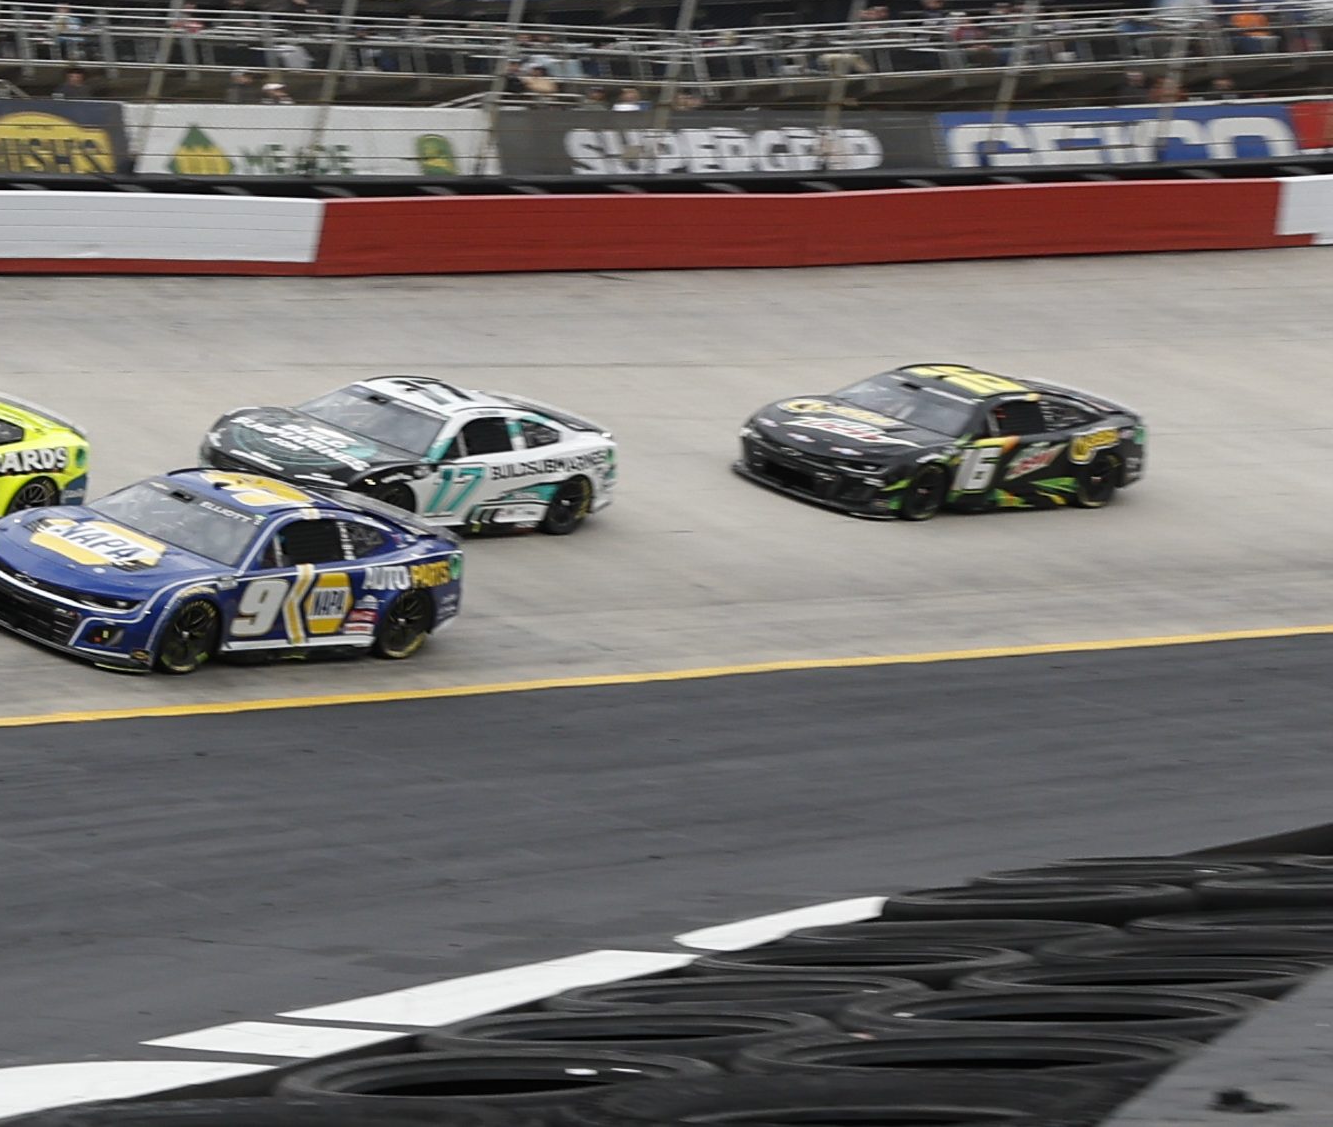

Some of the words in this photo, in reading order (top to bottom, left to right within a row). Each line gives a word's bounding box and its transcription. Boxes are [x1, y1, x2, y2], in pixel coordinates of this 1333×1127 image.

[954, 448, 1000, 491] 16
[426, 468, 483, 515] 17
[199, 501, 251, 523] ELLIOTT
[64, 524, 145, 561] NAPA
[362, 566, 411, 590] AUTO
[230, 578, 289, 636] 9
